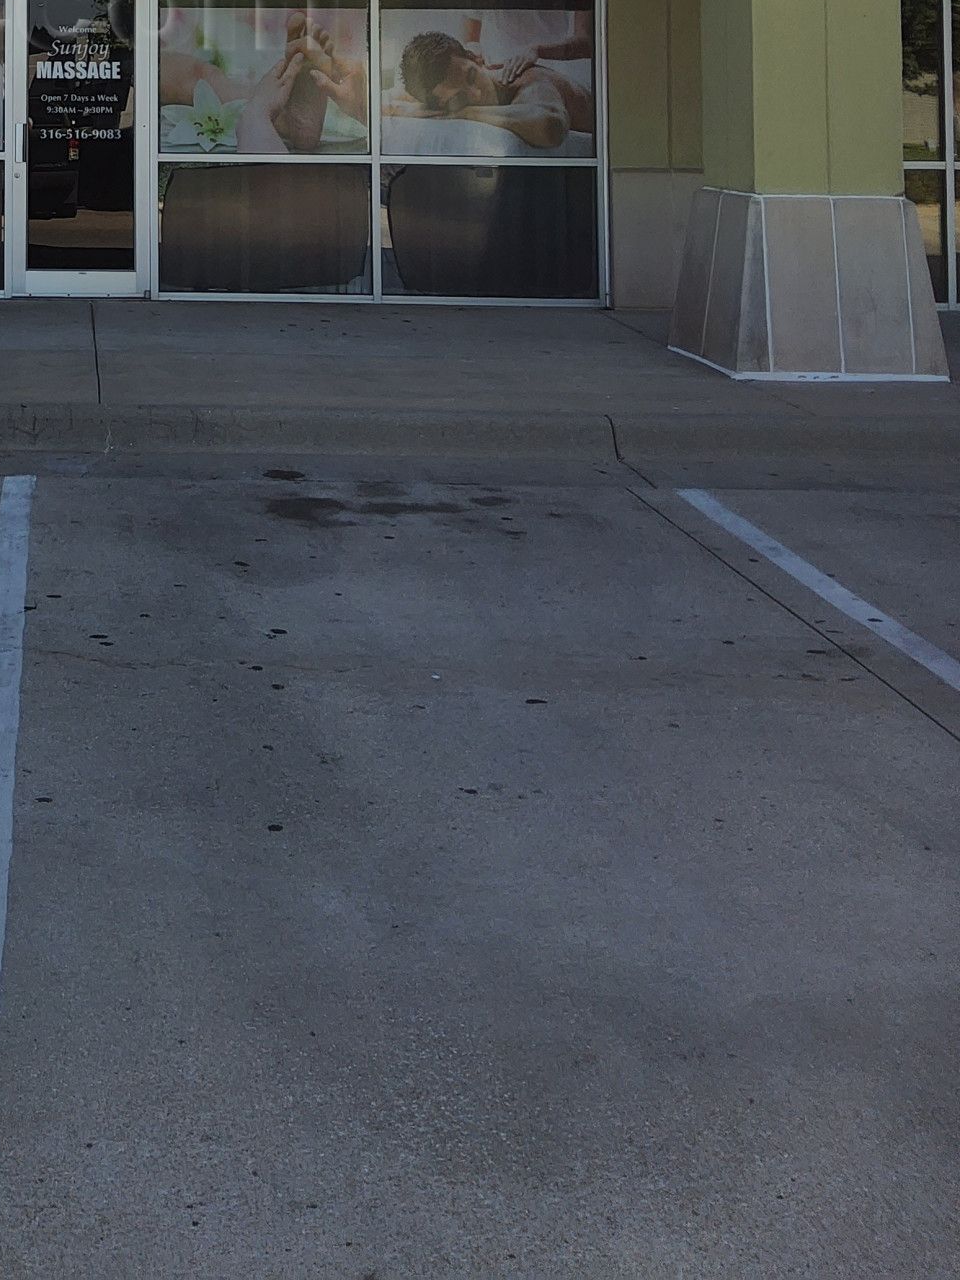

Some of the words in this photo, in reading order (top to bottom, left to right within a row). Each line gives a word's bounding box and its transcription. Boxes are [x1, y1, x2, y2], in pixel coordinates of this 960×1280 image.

[47, 40, 110, 61] Sunjoy
[36, 61, 121, 80] MASSAGE
[40, 94, 62, 103] Open
[63, 94, 69, 102] 7
[70, 94, 89, 103] Days
[97, 94, 119, 102] Week
[46, 106, 76, 114] 9:30AM
[40, 128, 122, 140] 316-516-9083
